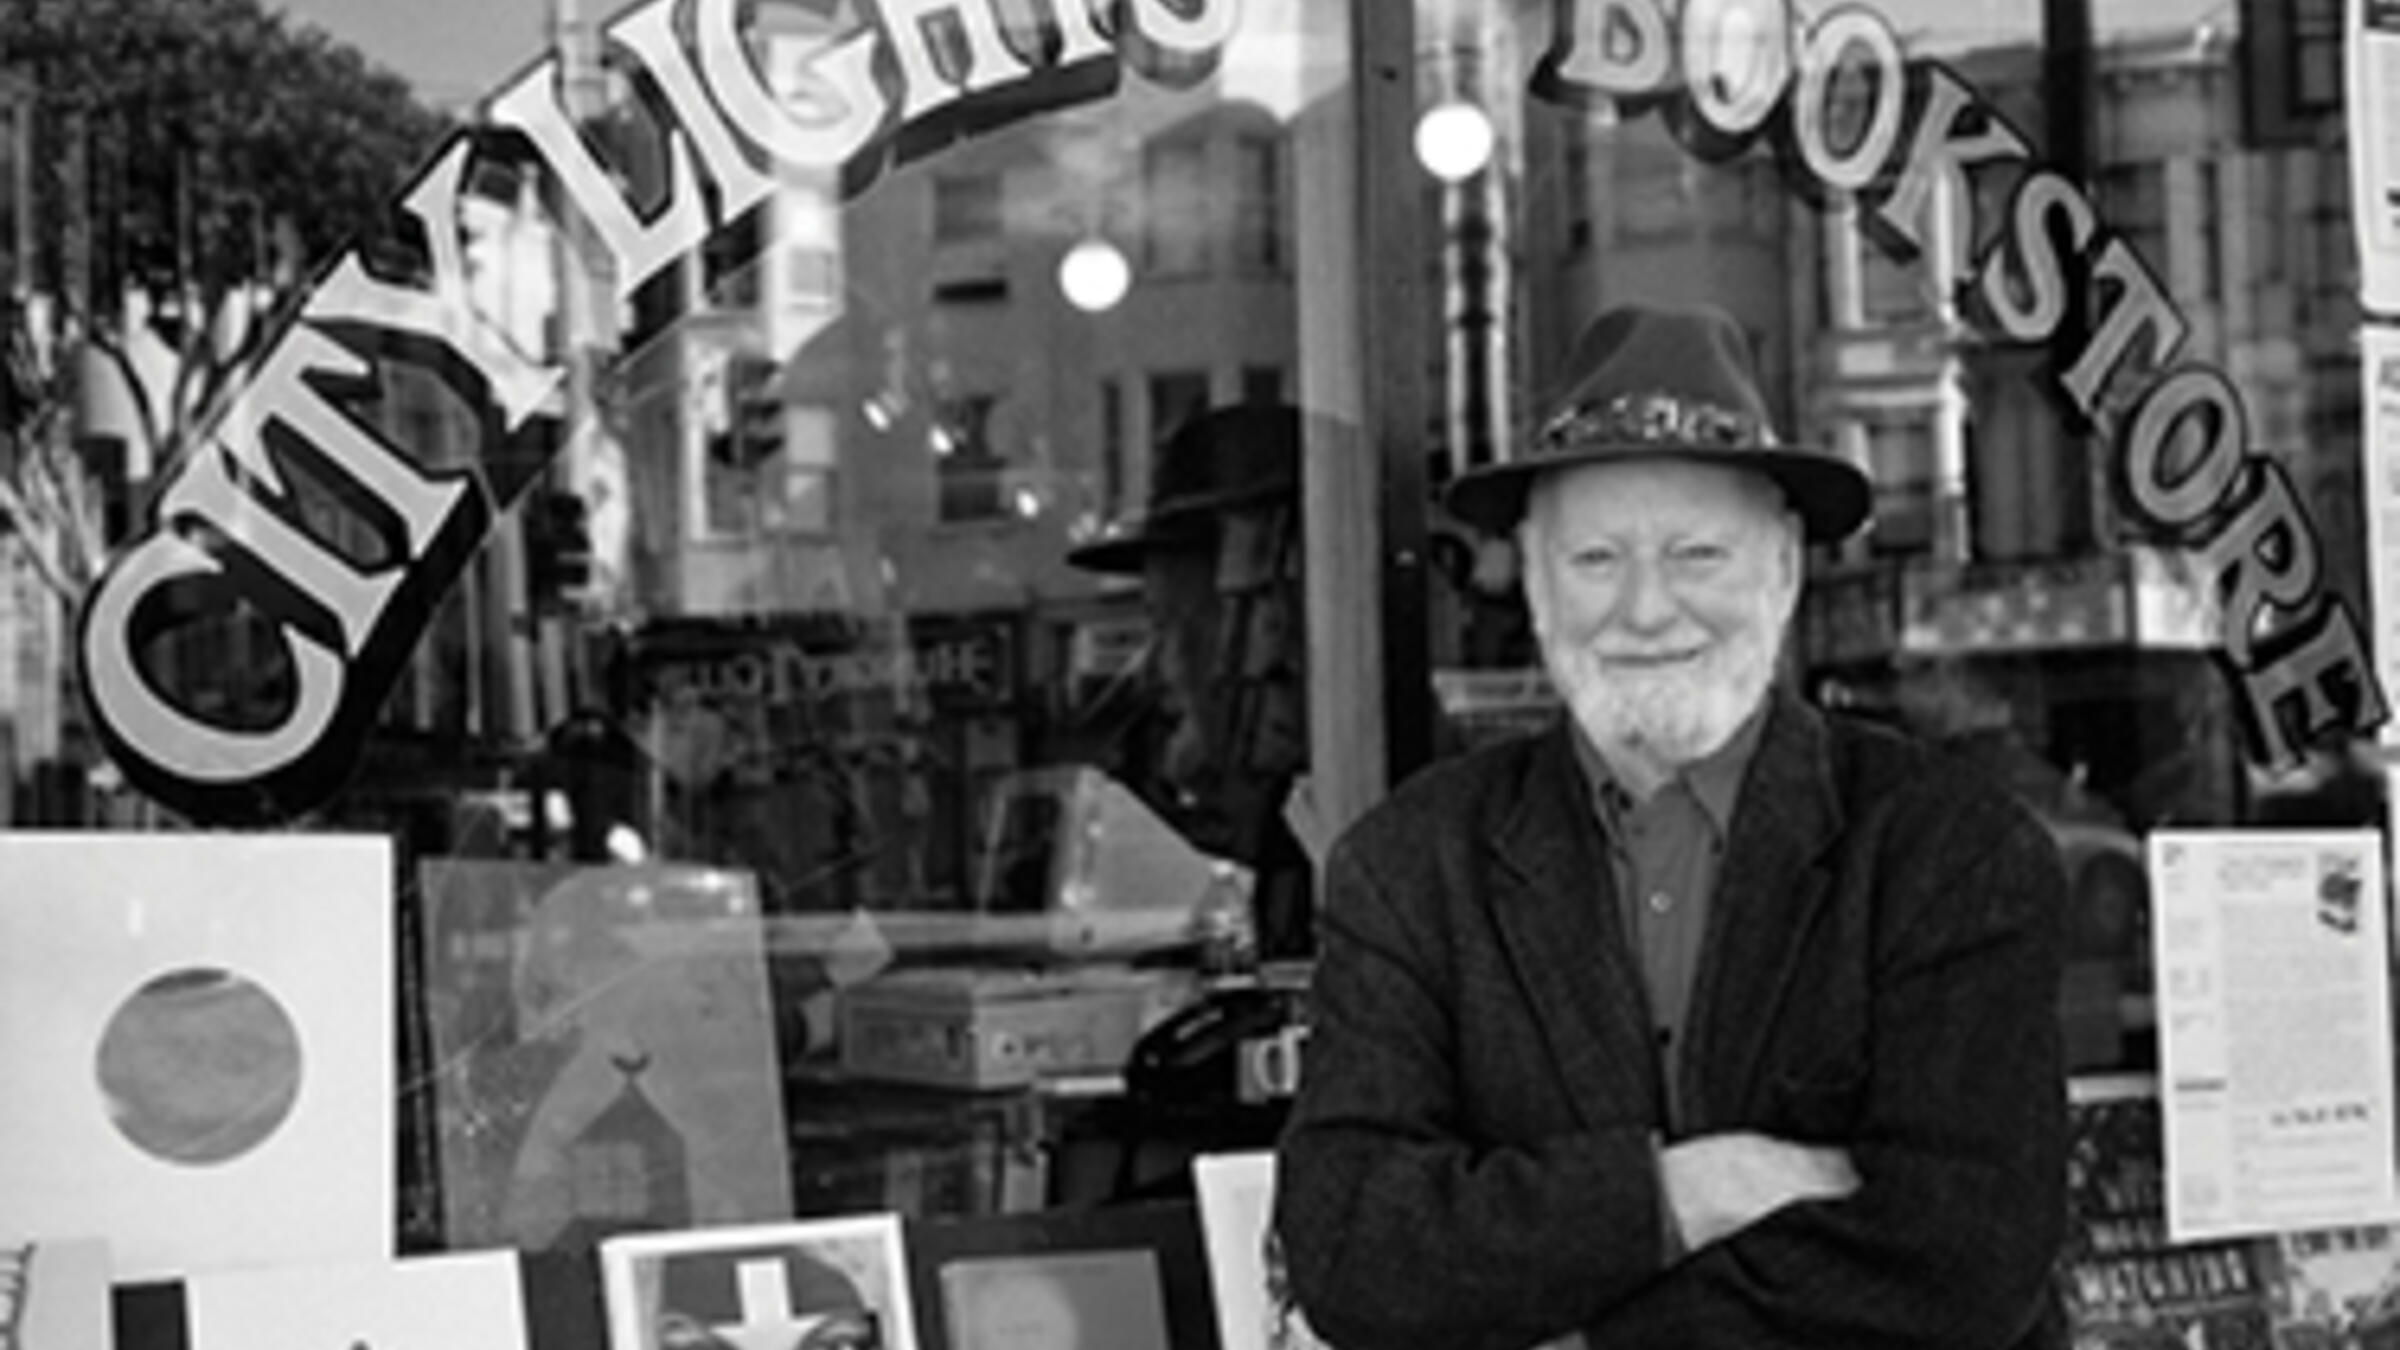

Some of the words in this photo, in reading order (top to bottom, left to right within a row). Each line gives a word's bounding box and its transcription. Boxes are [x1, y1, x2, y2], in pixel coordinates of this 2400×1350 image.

[84, 137, 570, 784] CITY
[489, 0, 1240, 300] LIGH
[1556, 0, 2387, 778] BOOKSTORE
